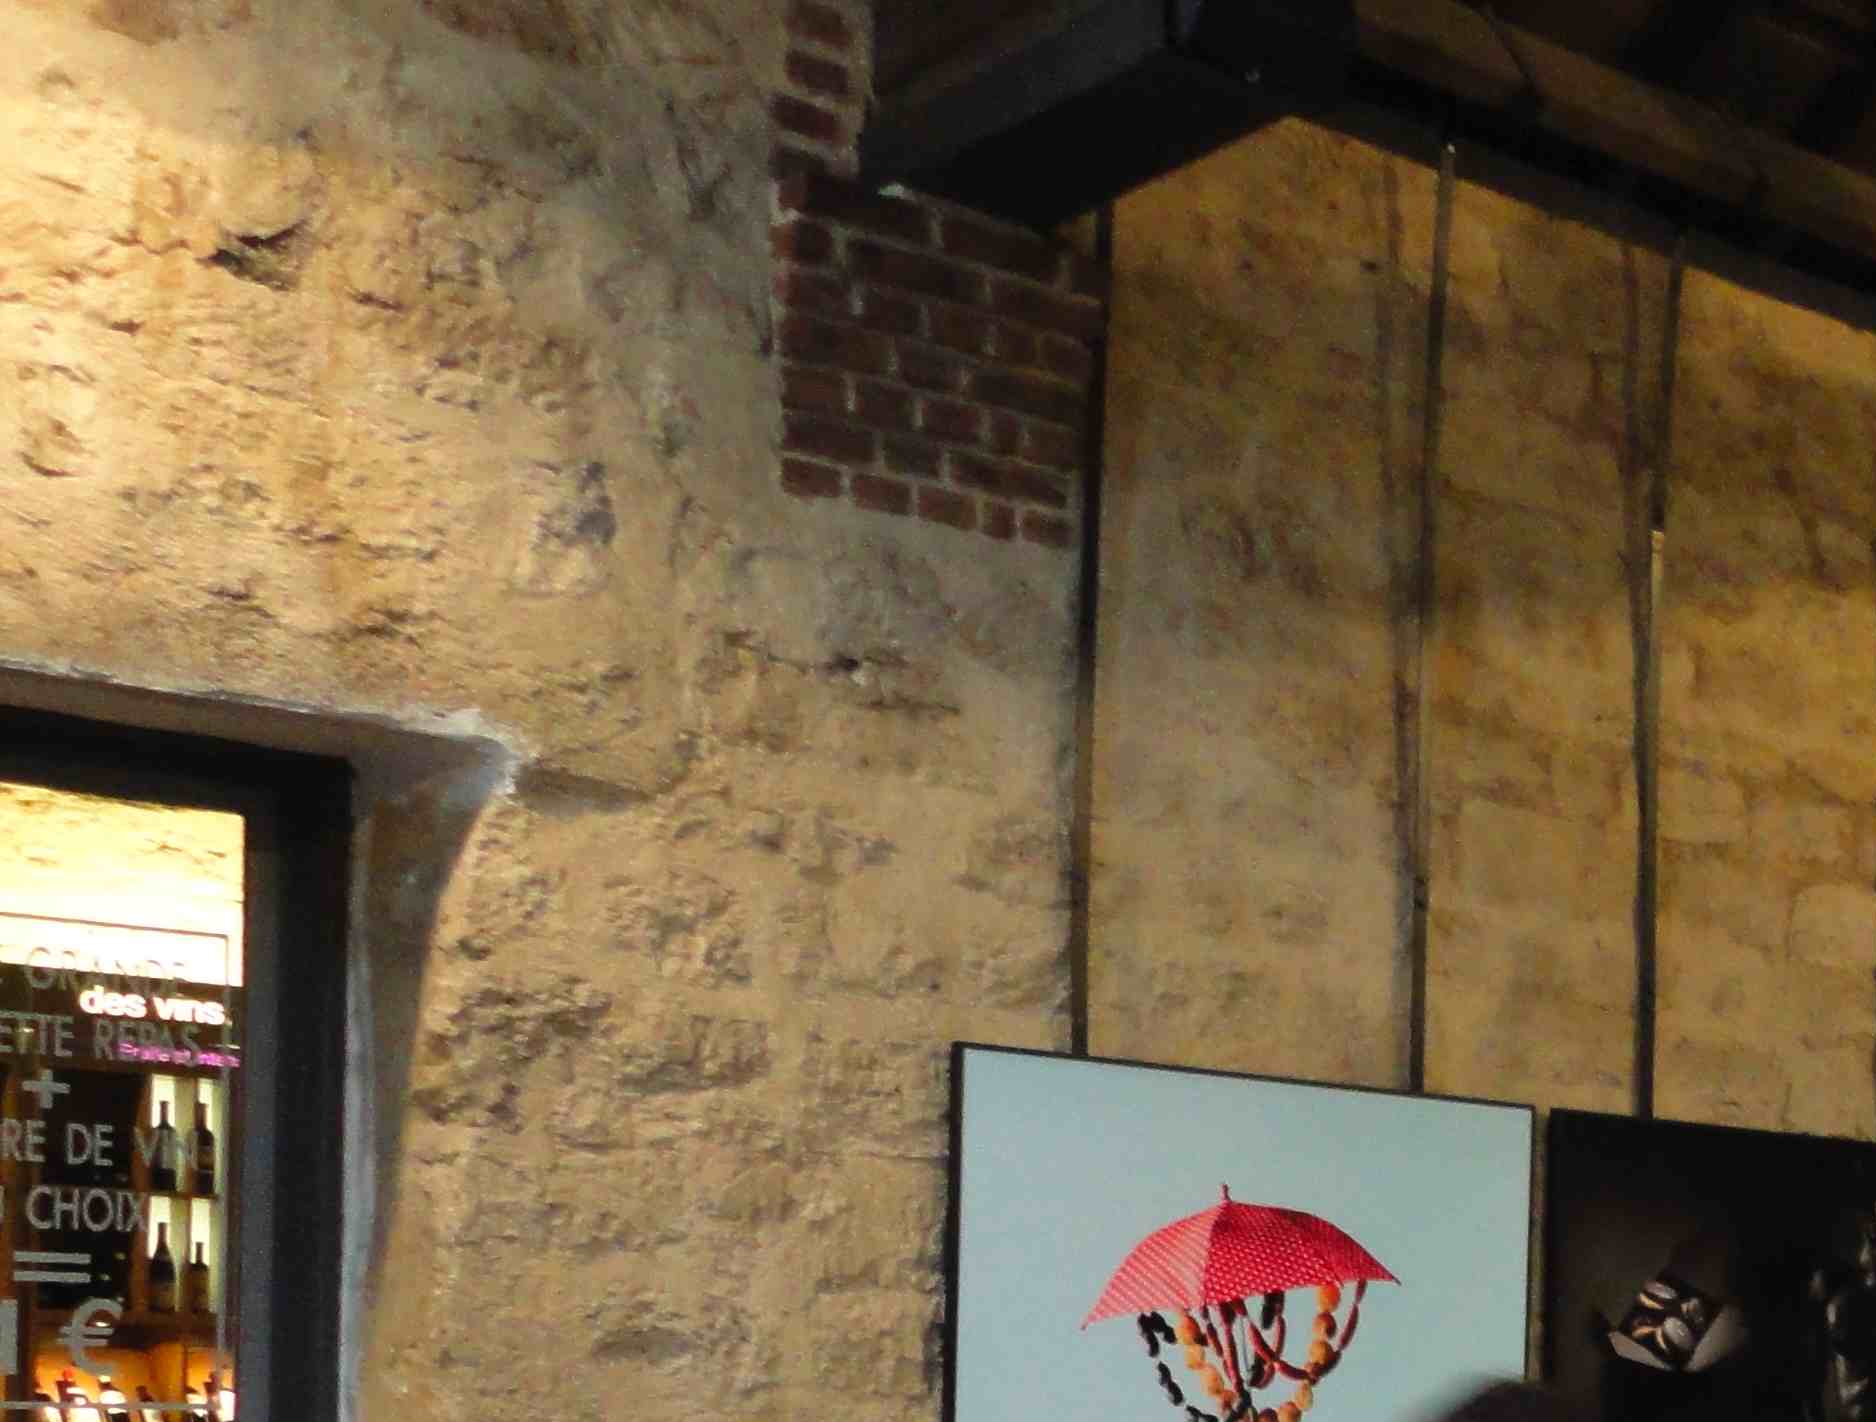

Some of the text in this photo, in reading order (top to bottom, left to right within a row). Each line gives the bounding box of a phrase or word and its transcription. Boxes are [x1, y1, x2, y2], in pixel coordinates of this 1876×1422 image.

[78, 984, 227, 1026] des vins
[66, 1123, 113, 1167] DE
[26, 1184, 149, 1233] CHOIX
